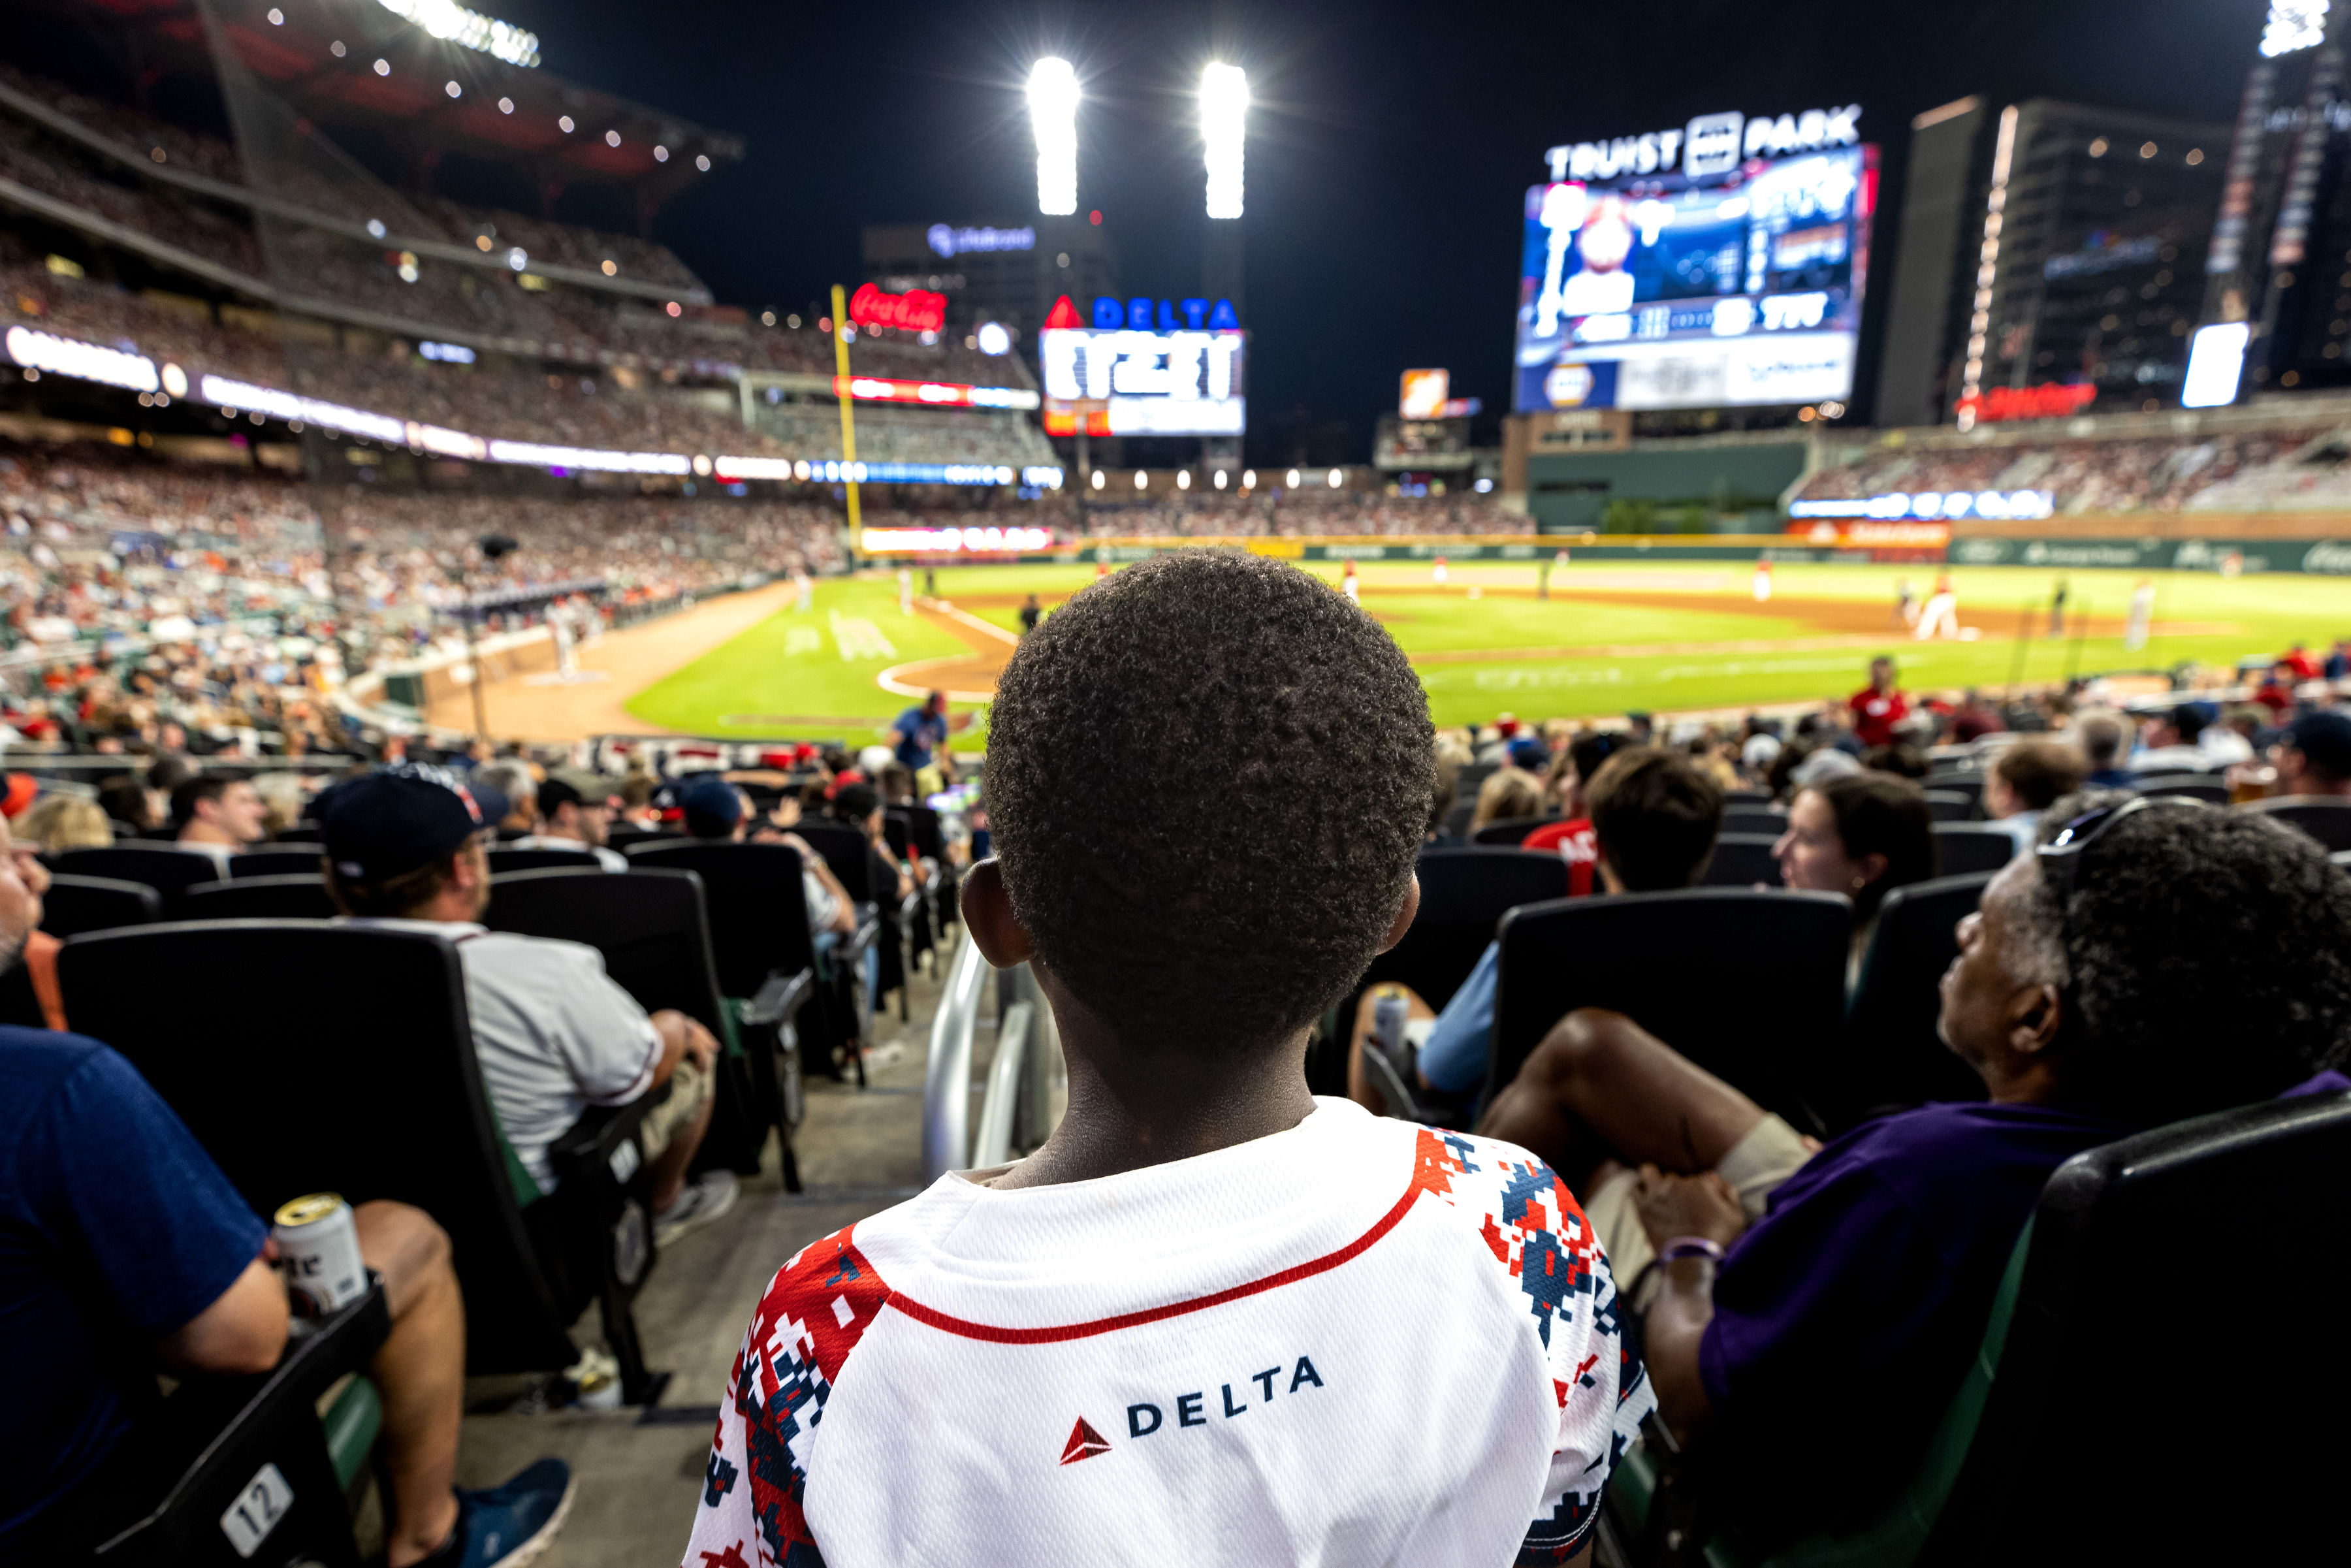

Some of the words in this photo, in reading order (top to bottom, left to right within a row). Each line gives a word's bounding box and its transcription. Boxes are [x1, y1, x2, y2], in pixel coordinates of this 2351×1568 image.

[1545, 129, 1683, 182] TRUIST
[1744, 104, 1863, 157] PARK
[1093, 296, 1239, 330] DELTA
[1127, 1355, 1324, 1439] DELTA
[237, 1484, 281, 1535] 12
